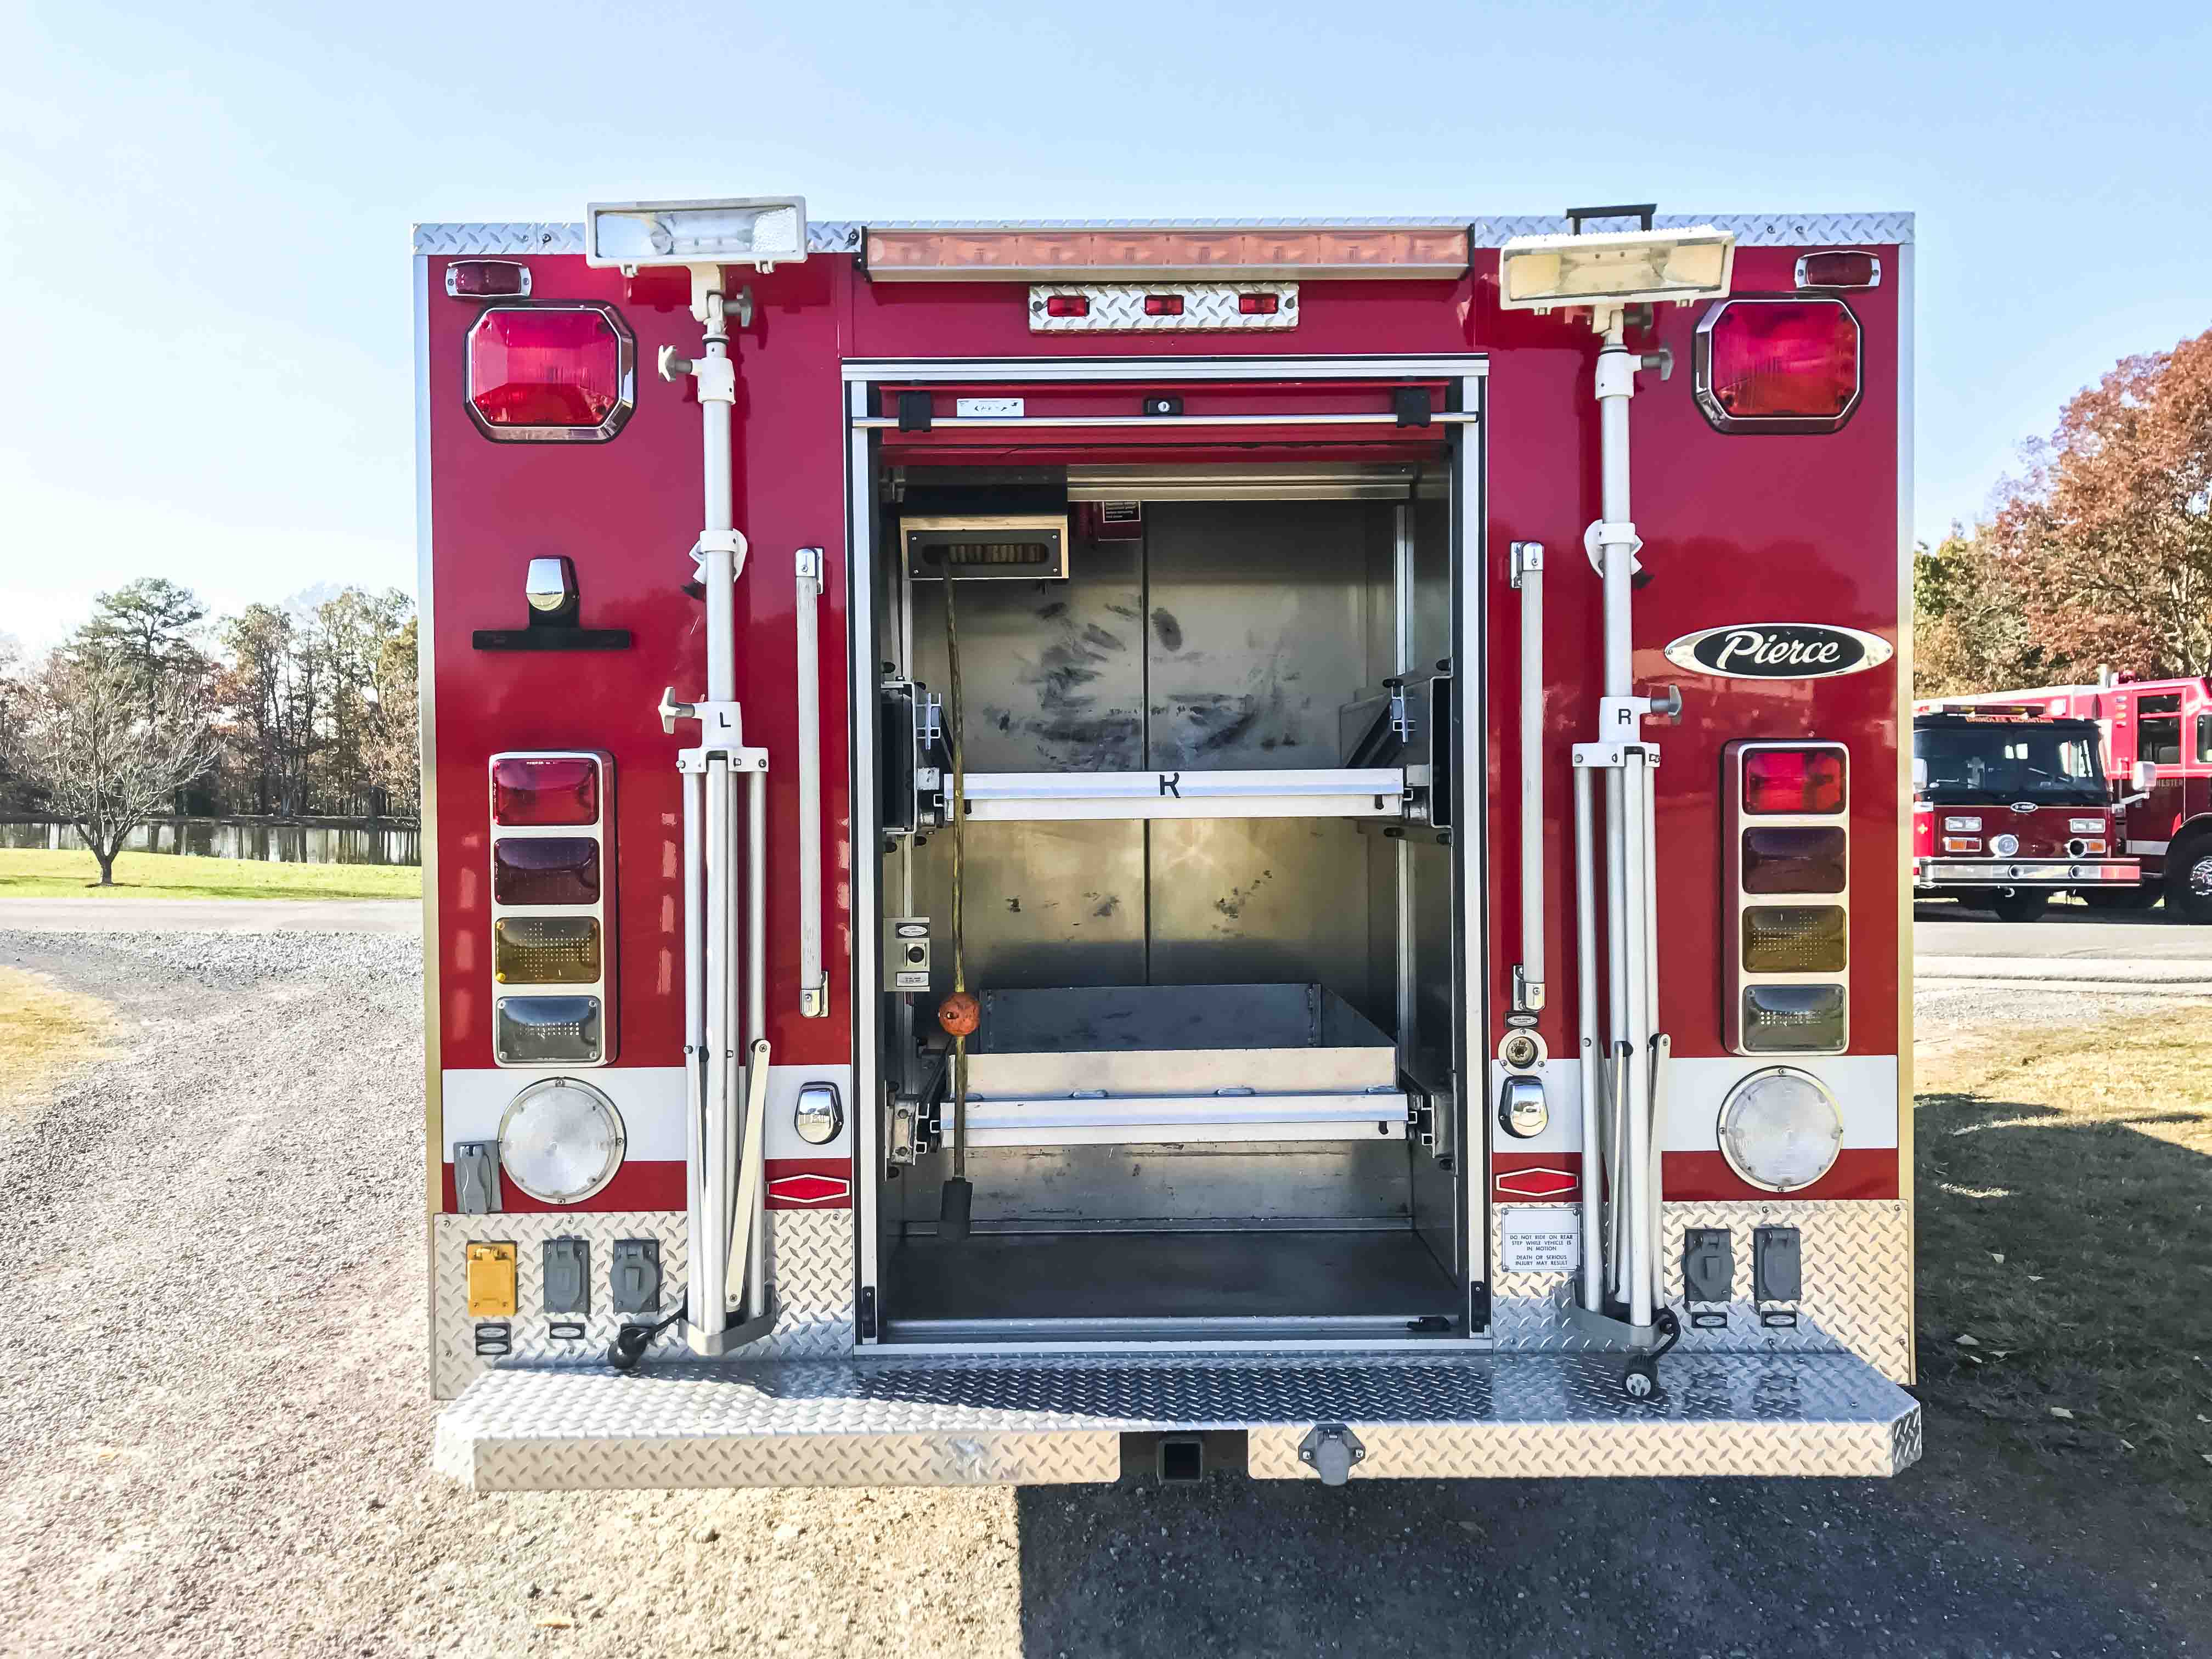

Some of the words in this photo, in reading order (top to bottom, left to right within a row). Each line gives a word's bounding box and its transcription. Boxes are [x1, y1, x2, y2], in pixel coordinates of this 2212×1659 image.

[1717, 630, 1841, 670] Pierce
[719, 712, 731, 728] L
[1618, 708, 1632, 725] R
